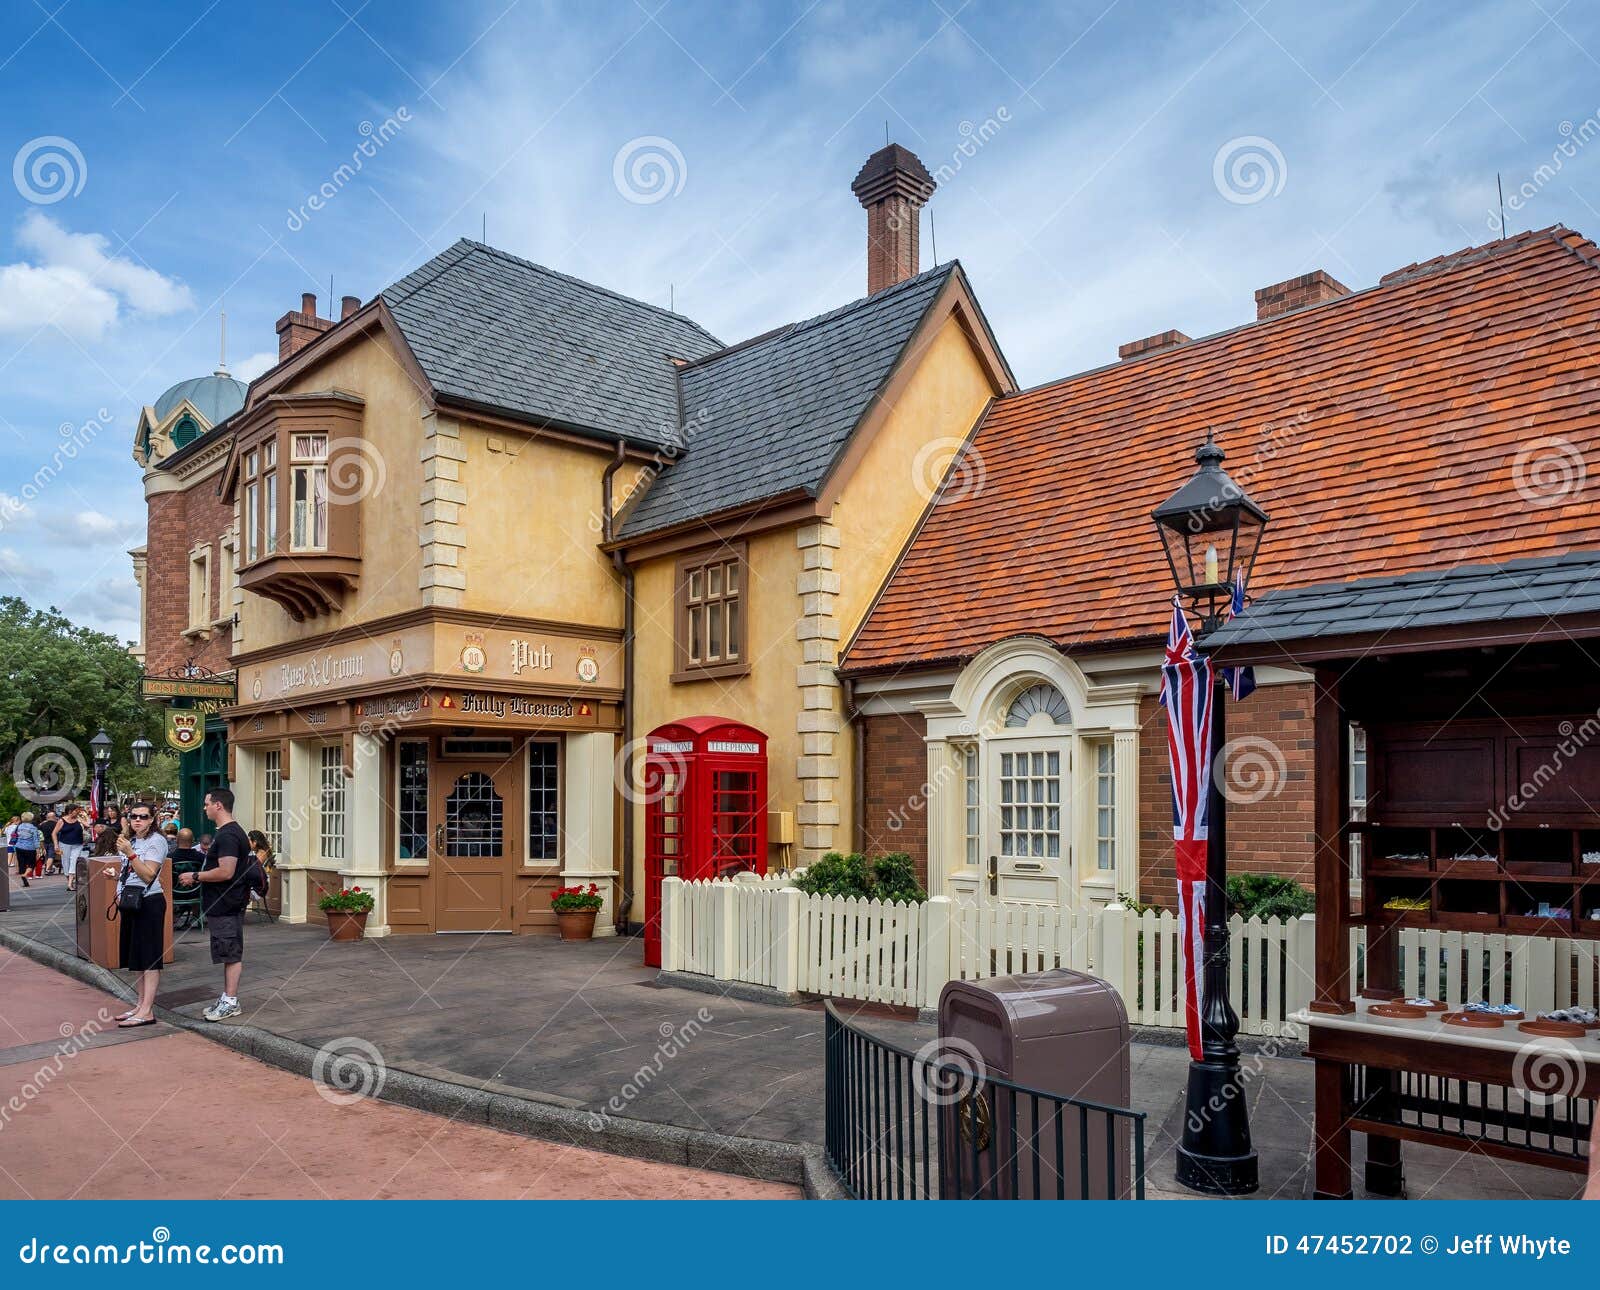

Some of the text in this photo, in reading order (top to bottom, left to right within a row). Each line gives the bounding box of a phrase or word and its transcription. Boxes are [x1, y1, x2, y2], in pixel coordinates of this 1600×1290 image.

[511, 639, 553, 675] Pub
[281, 654, 364, 692] Rose & Crown
[147, 682, 177, 693] ROSE
[189, 684, 231, 696] CROWN
[460, 692, 574, 719] Fully Licensed
[654, 742, 692, 753] TELEPHONE
[709, 742, 757, 753] TELEPHONE
